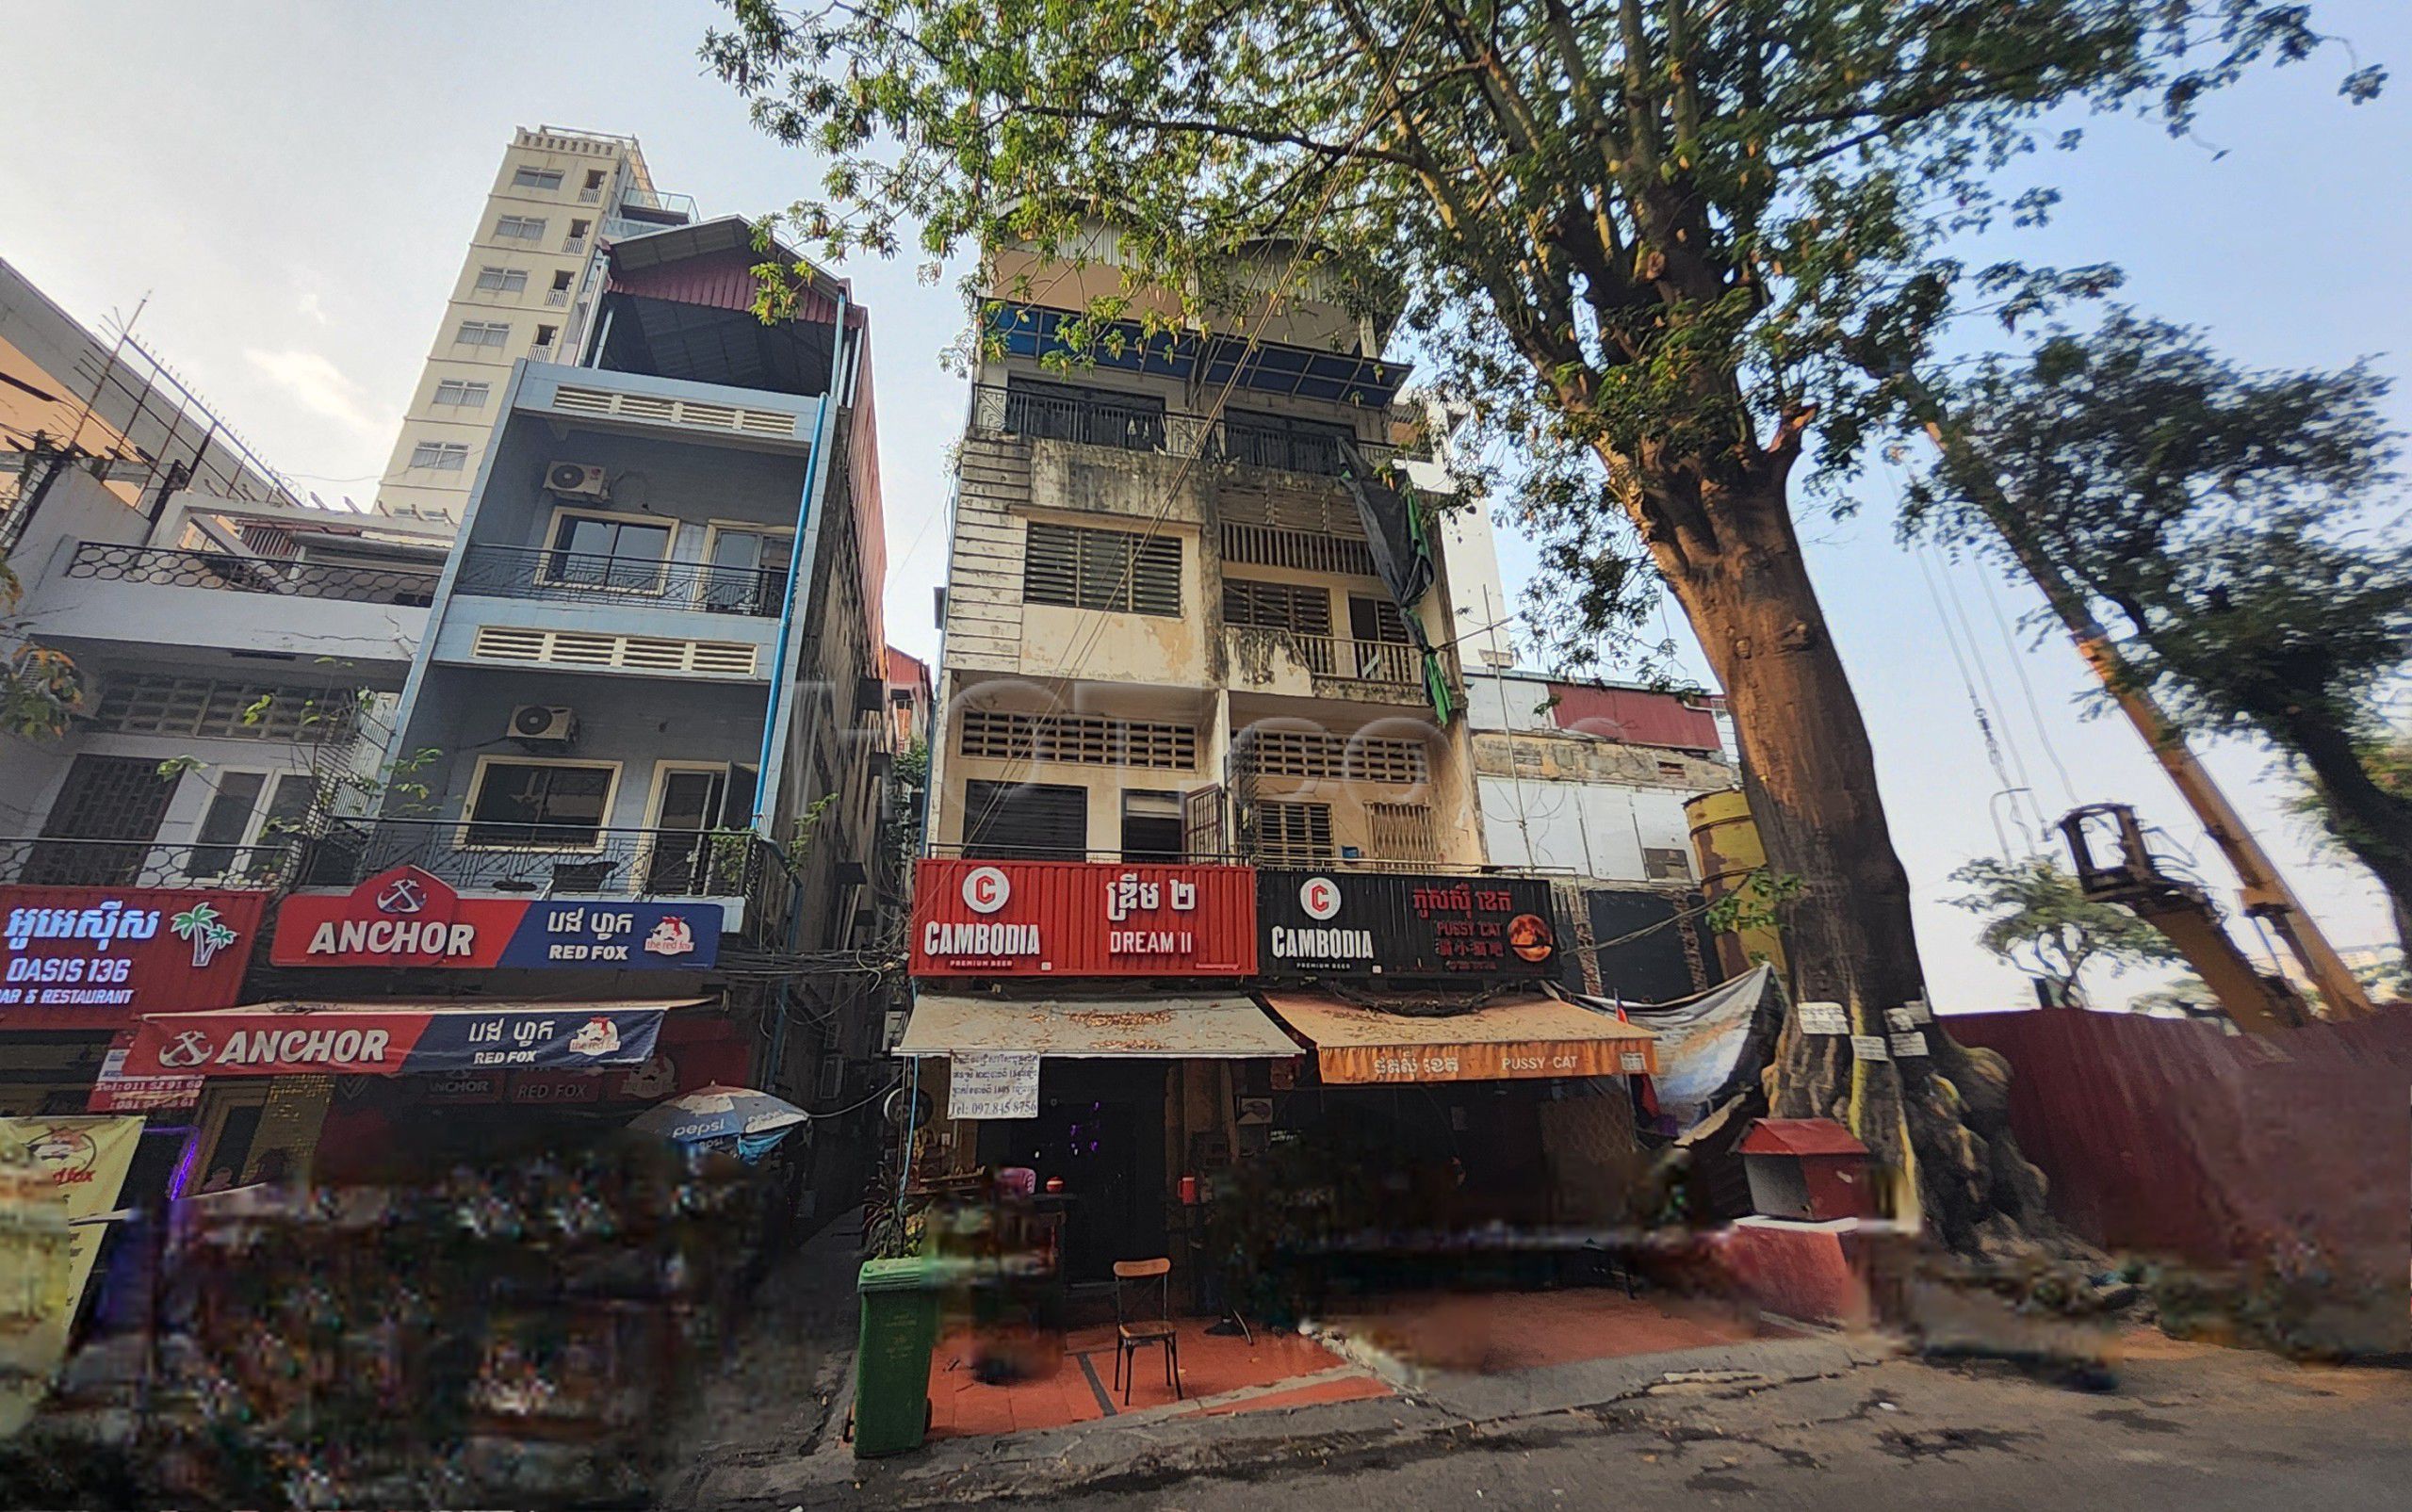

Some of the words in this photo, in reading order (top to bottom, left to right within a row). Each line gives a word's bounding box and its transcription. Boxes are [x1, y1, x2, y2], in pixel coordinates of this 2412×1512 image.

[1170, 879, 1195, 910] ២
[306, 919, 476, 957] ANCHOR
[924, 920, 1040, 956] CAMBODIA
[1437, 921, 1475, 936] PUSSY
[1479, 922, 1502, 936] CAT
[548, 944, 589, 960] RED
[591, 945, 629, 961] FOX
[1110, 931, 1174, 953] DREAM
[1272, 925, 1374, 959] CAMBODIA
[6, 957, 86, 984] OASIS
[87, 957, 132, 984] 136
[0, 988, 23, 1004] AR
[40, 988, 135, 1005] RESTAURANT
[215, 1028, 390, 1066] ANCHOR
[473, 1051, 505, 1065] RED
[507, 1050, 538, 1064] FOX
[1502, 1056, 1545, 1070] PUSSY
[1553, 1055, 1577, 1069] CAT
[517, 1084, 548, 1098] RED
[555, 1083, 588, 1097] FOX
[673, 1118, 725, 1138] pepsi
